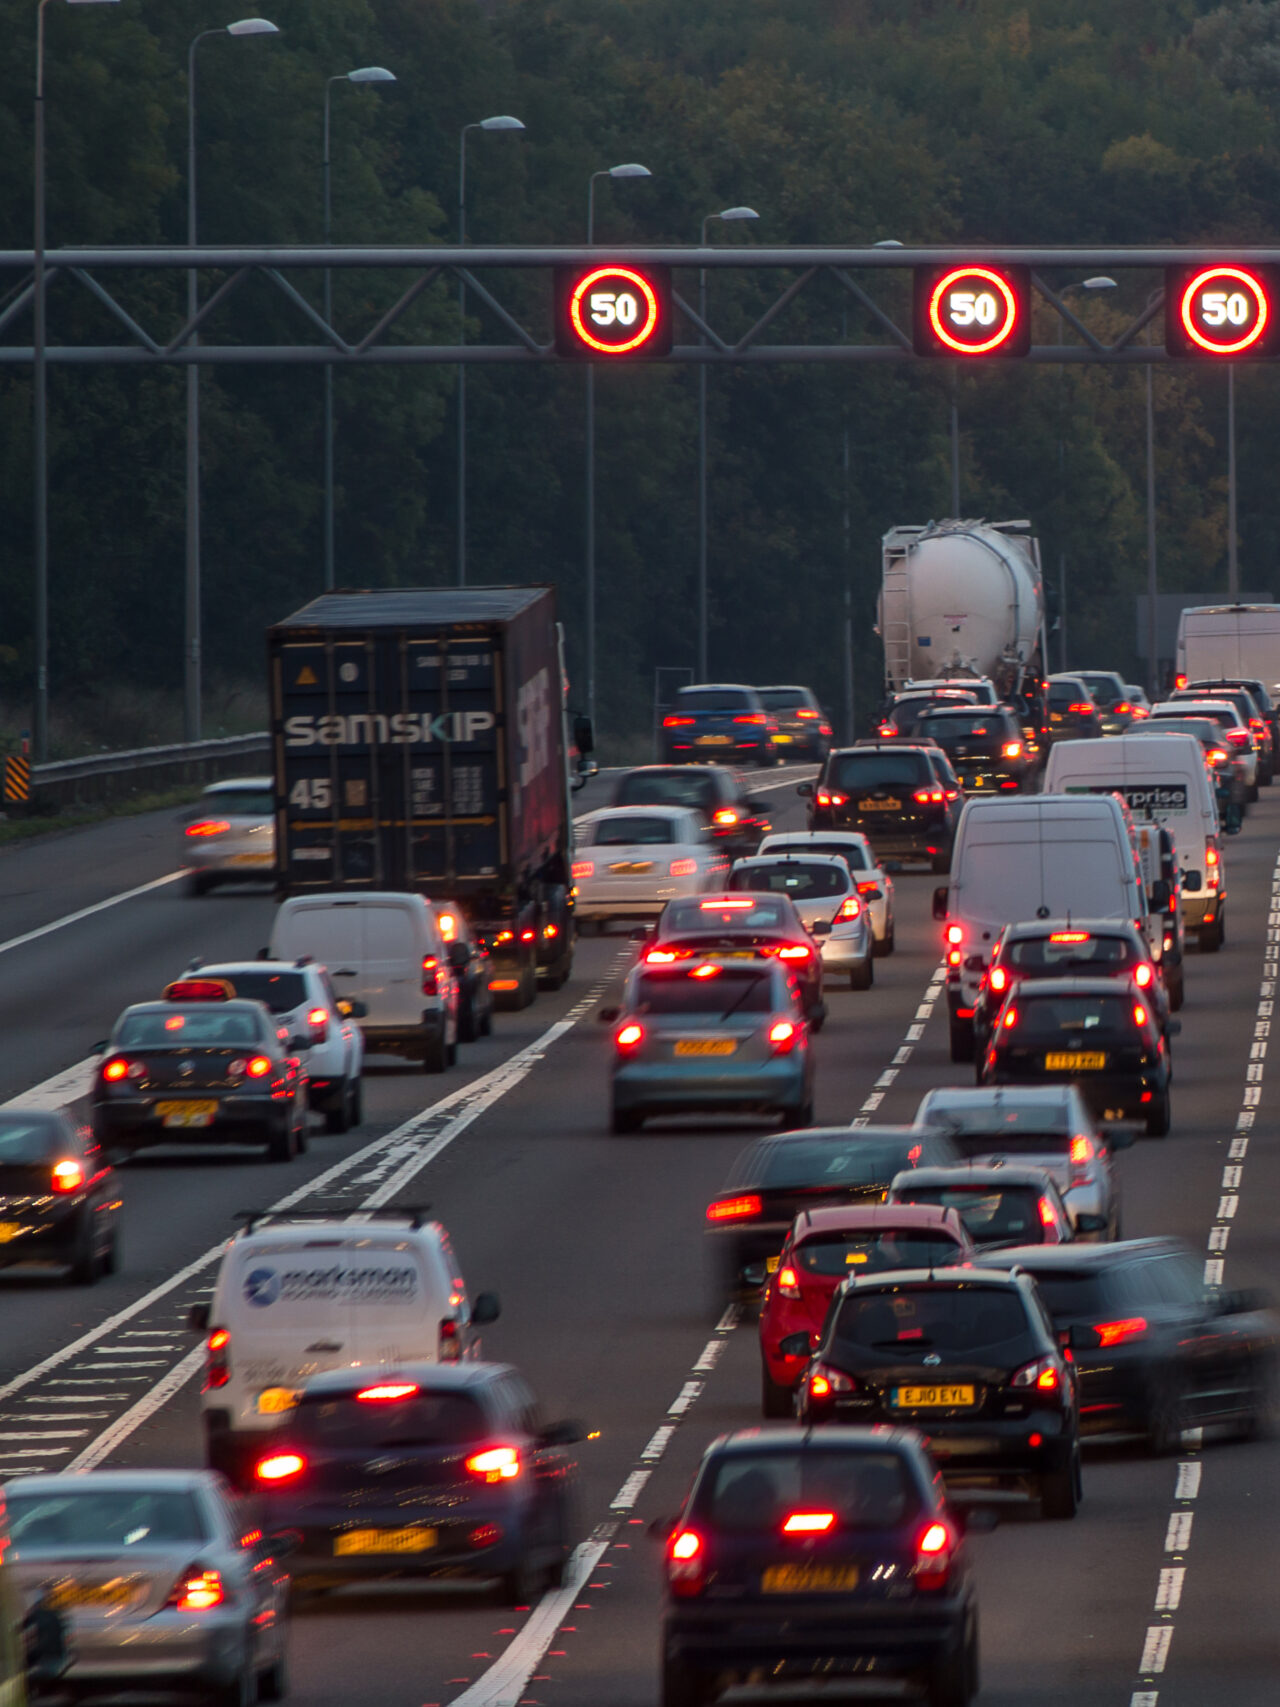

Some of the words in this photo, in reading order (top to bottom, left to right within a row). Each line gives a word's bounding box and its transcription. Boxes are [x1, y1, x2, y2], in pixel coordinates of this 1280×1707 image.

[590, 292, 639, 327] 50
[949, 292, 998, 327] 50
[1201, 292, 1249, 326] 50
[289, 778, 332, 809] 45
[1126, 787, 1186, 807] rprise
